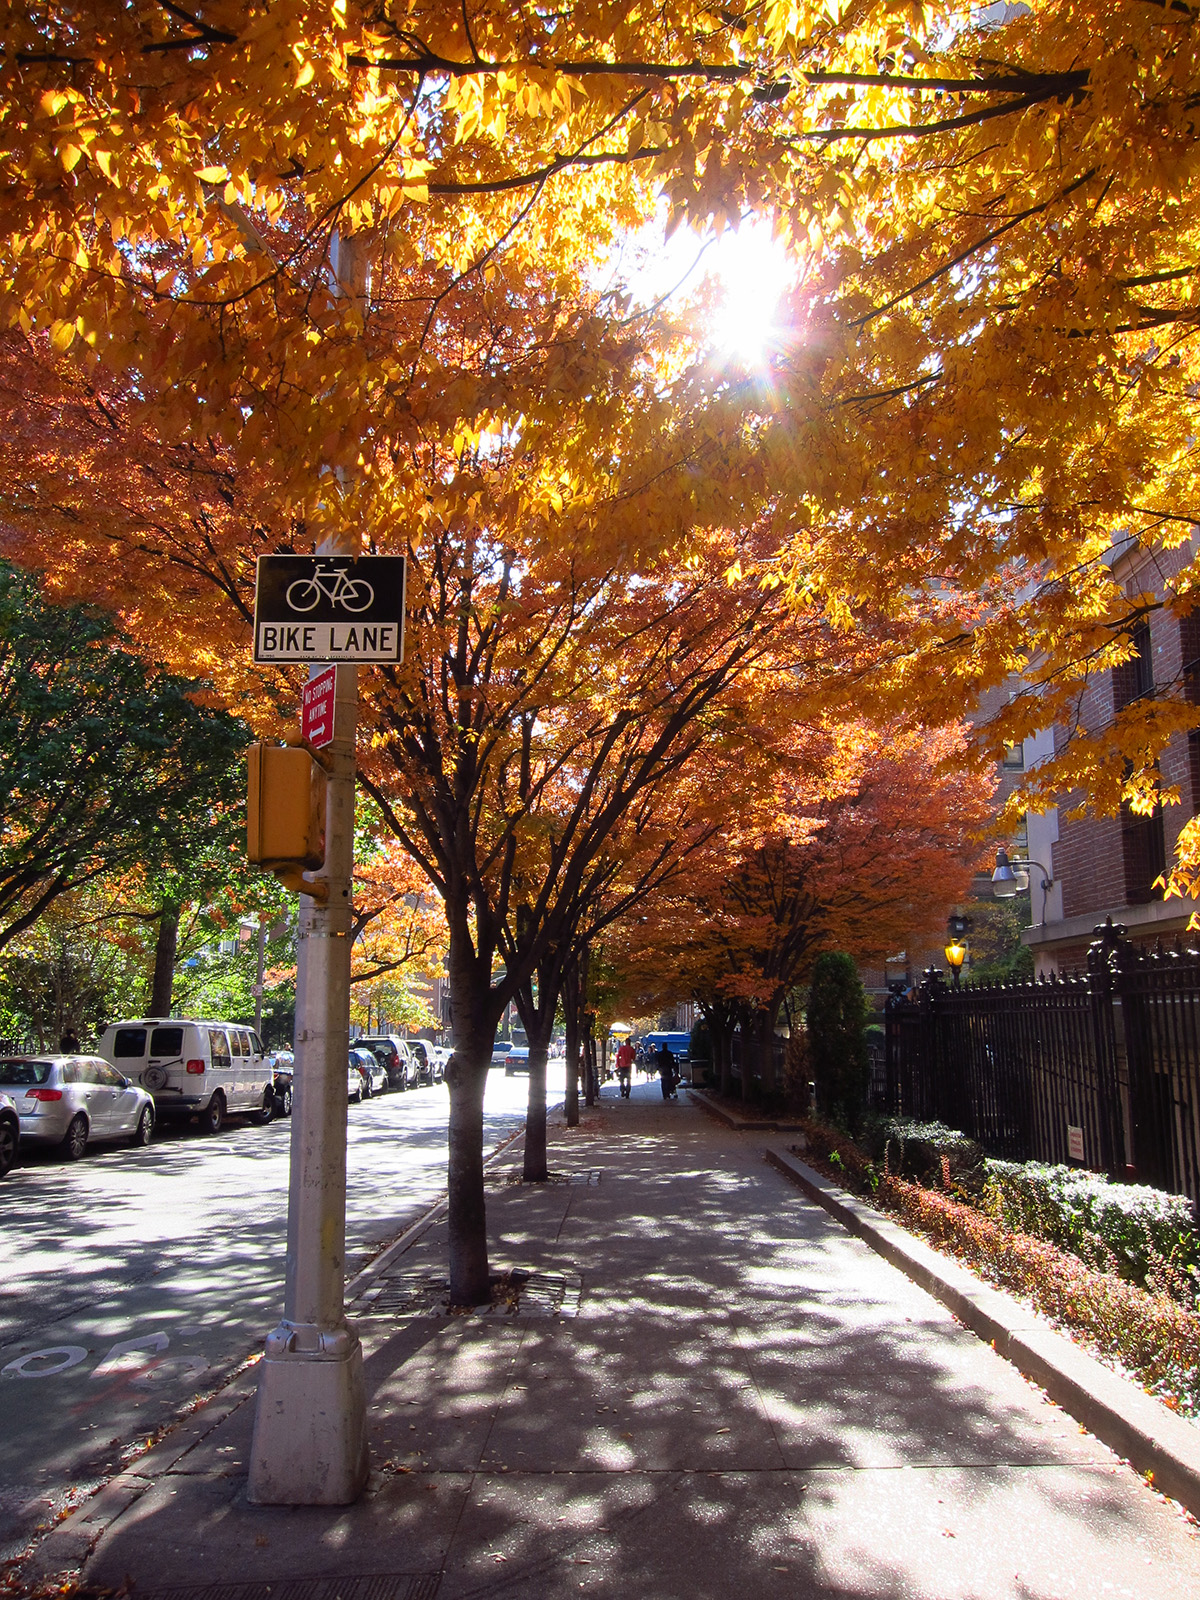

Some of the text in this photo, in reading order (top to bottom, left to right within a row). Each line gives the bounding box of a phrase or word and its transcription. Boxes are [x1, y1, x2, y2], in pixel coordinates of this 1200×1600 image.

[263, 627, 393, 651] BIKE LANE
[304, 676, 333, 706] NO STOPPING
